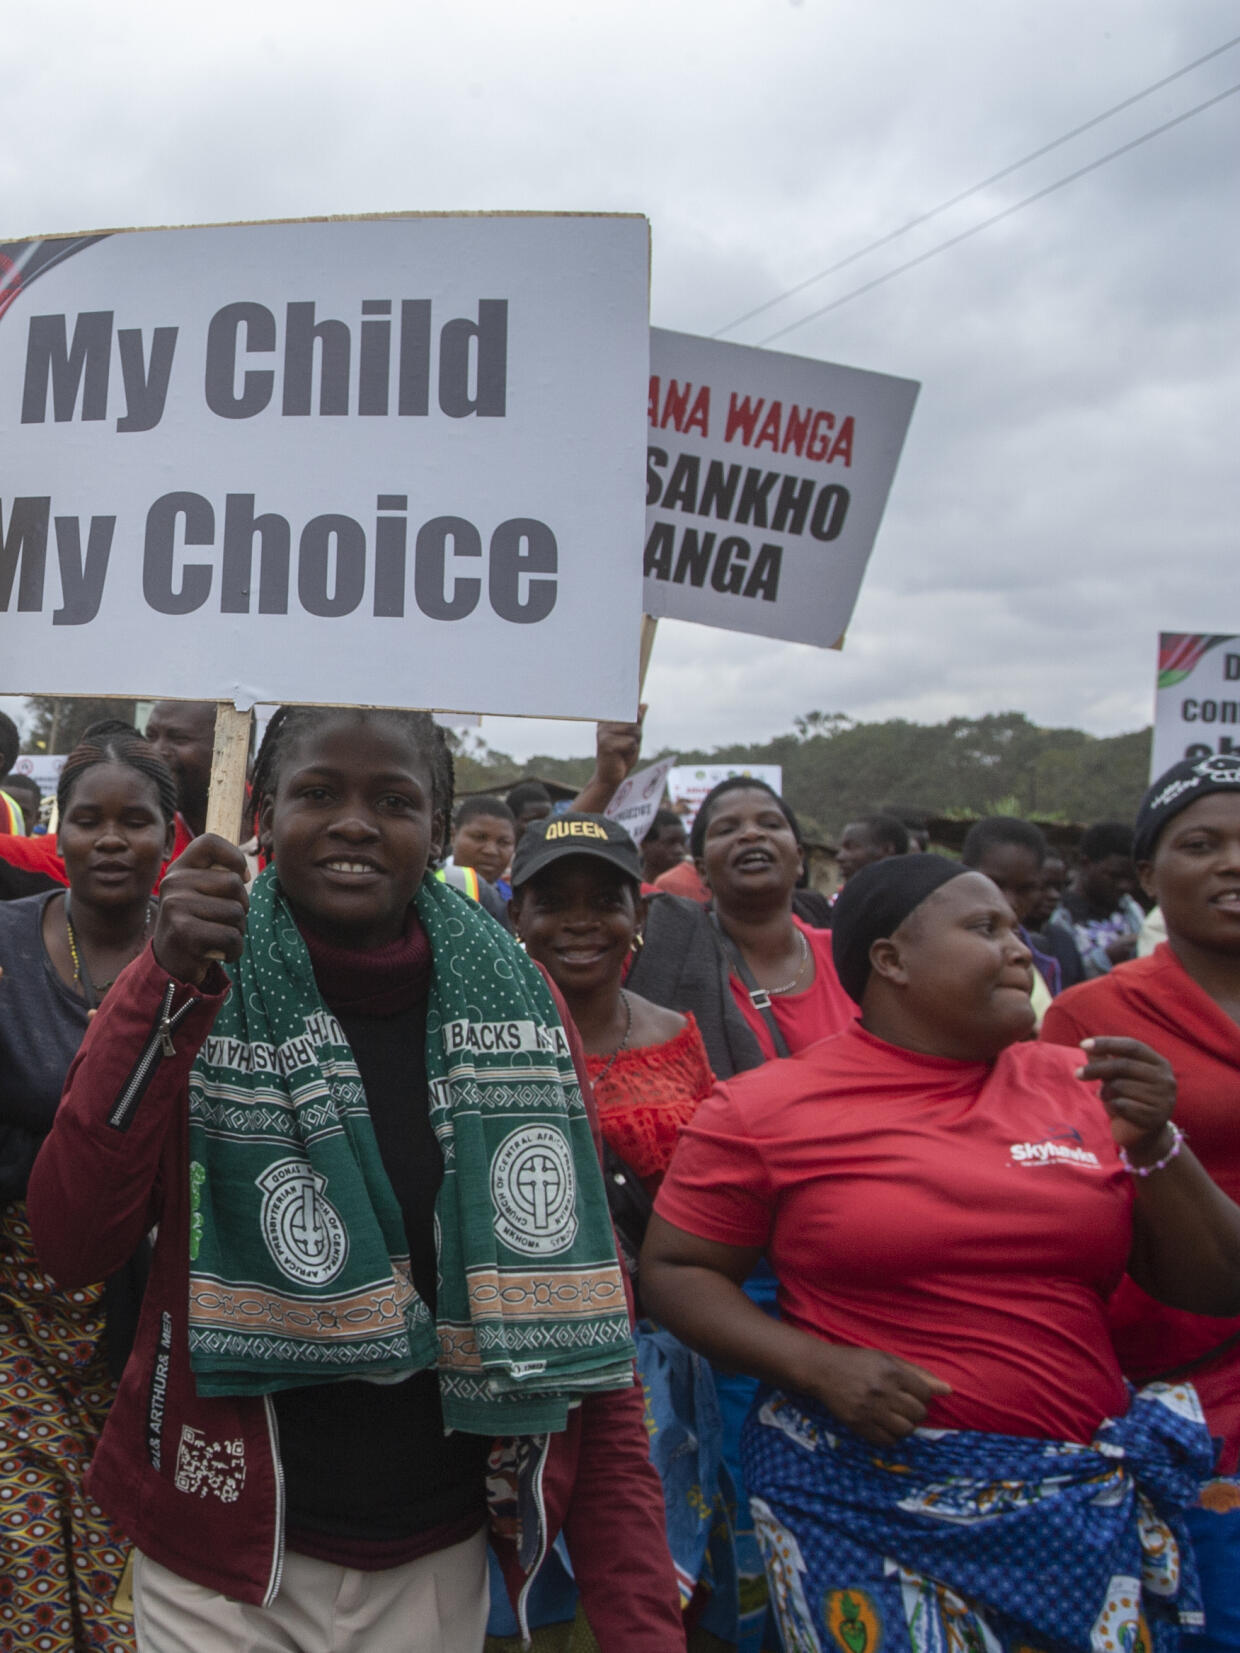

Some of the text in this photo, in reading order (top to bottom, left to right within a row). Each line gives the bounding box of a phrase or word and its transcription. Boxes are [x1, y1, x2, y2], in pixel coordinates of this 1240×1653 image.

[21, 299, 508, 432] My Child
[724, 391, 856, 469] WANGA
[143, 492, 557, 623] Choice
[545, 820, 609, 841] QUEEN
[498, 1136, 533, 1172] CENTRAL
[271, 1165, 301, 1183] SYNOD
[498, 1193, 528, 1226] CHURCH
[322, 1234, 342, 1275] CENTRAL
